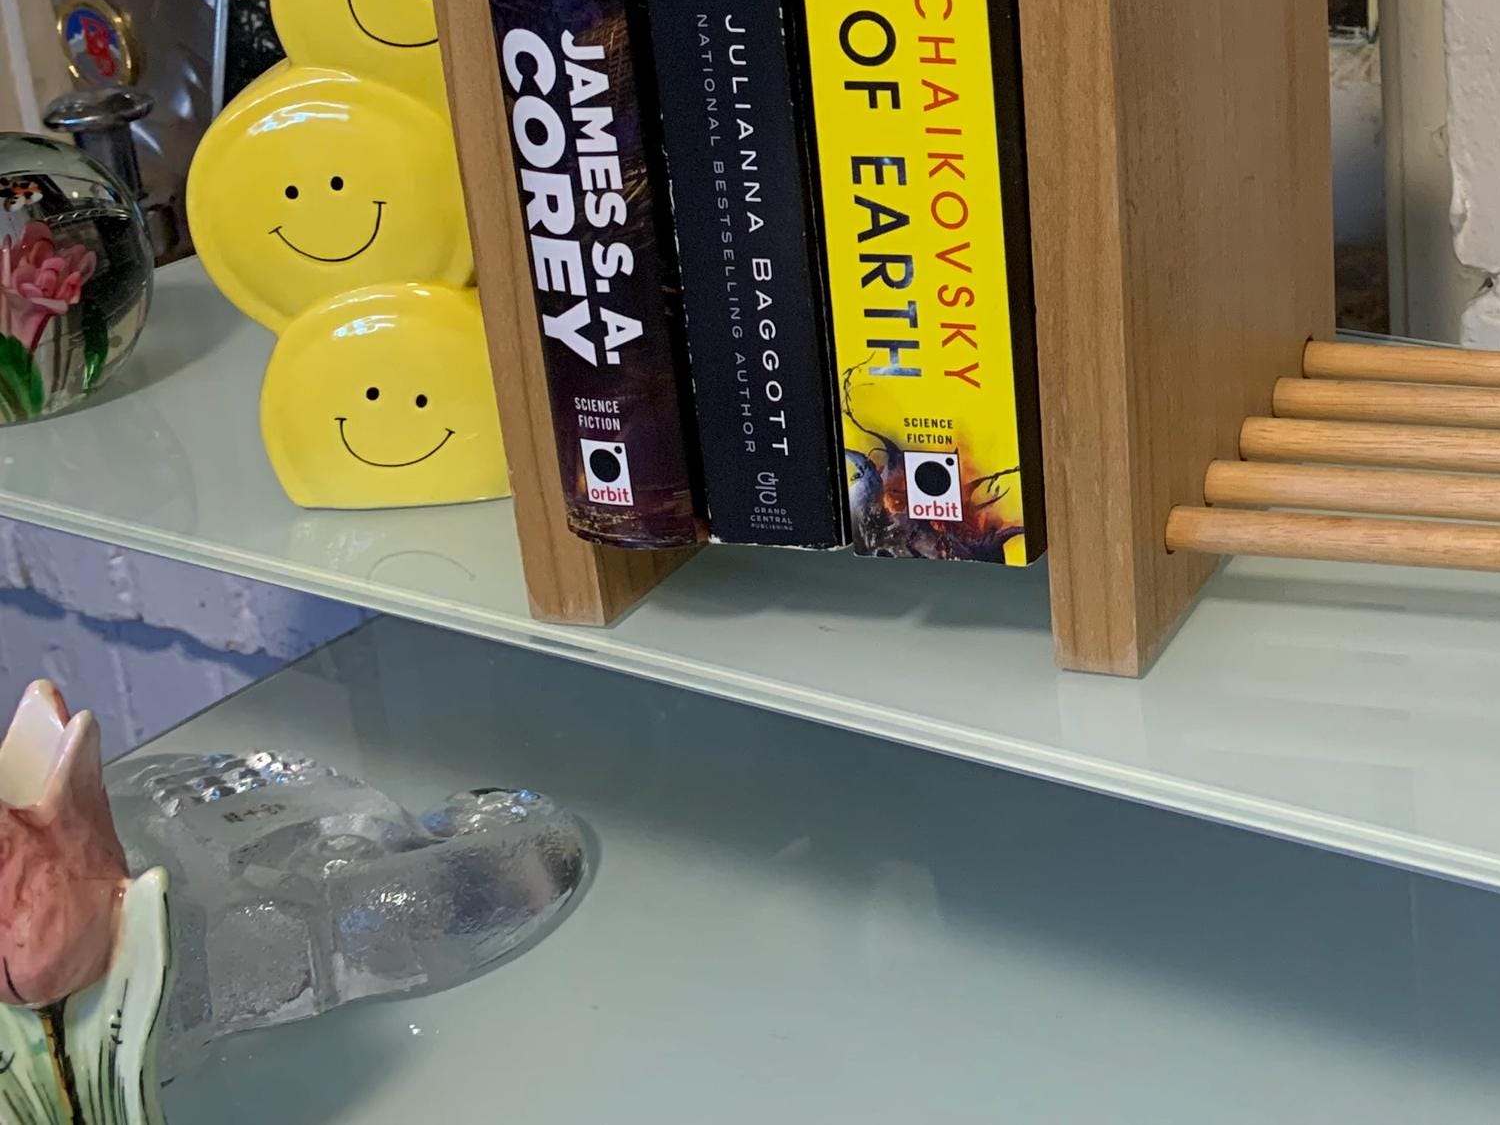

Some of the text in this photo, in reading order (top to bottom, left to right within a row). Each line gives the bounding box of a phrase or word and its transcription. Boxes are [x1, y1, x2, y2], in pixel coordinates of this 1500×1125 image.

[839, 9, 902, 112] OF
[560, 28, 629, 229] JAMES
[502, 27, 599, 368] COREY
[696, 13, 757, 453] NATIONAL BESTSELLING AUTHOR
[724, 14, 789, 457] JULIANNA BAGGOTT
[850, 154, 922, 378] EARTH
[574, 396, 620, 414] SCIENCE
[578, 414, 621, 431] FICTION
[903, 417, 954, 430] SCIENCE
[906, 433, 953, 445] FICTION
[591, 485, 631, 503] orbit
[753, 506, 787, 515] GRAND
[913, 500, 959, 518] orbit
[750, 515, 793, 525] CENTRAL
